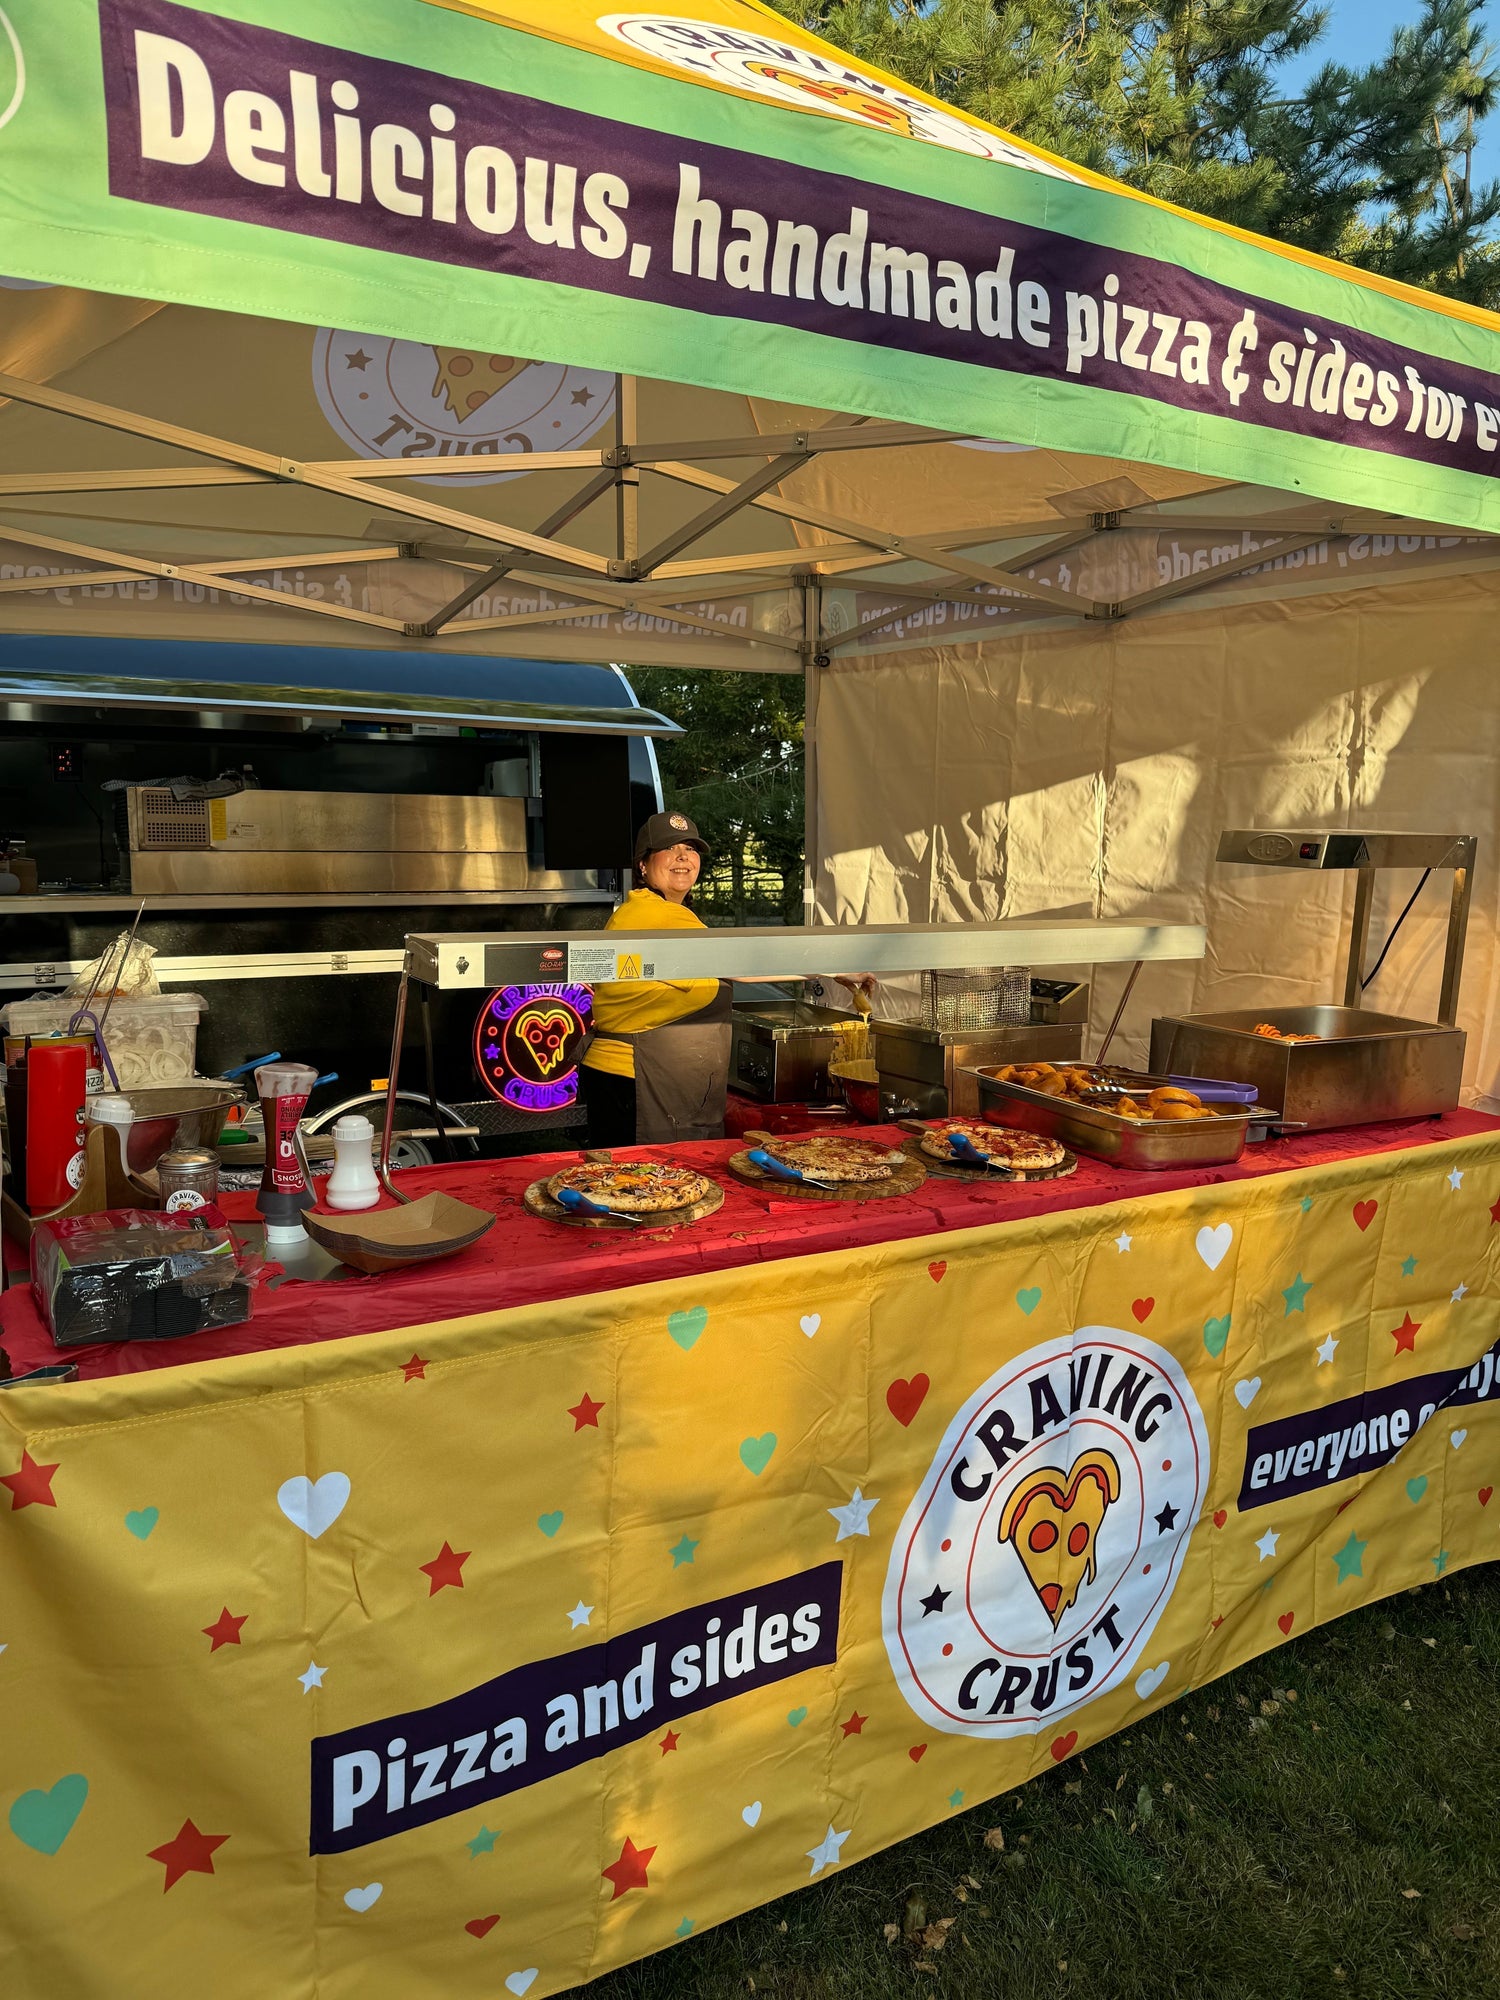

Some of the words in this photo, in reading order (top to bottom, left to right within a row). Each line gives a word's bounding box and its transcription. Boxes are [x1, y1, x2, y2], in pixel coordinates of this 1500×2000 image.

[134, 29, 652, 279] Delicious,
[671, 163, 1051, 348] handmade
[1066, 273, 1210, 374] pizza
[1221, 308, 1258, 406] &
[1262, 327, 1400, 427] sides
[1403, 365, 1468, 443] for
[504, 1071, 579, 1108] CRUST
[171, 1192, 200, 1204] CRAVING
[950, 1353, 1174, 1503] CRAVING
[1248, 1408, 1411, 1490] everyone
[957, 1602, 1125, 1716] CRUST
[332, 1714, 529, 1832] Pizza
[544, 1642, 658, 1753] and
[668, 1602, 822, 1699] sides
